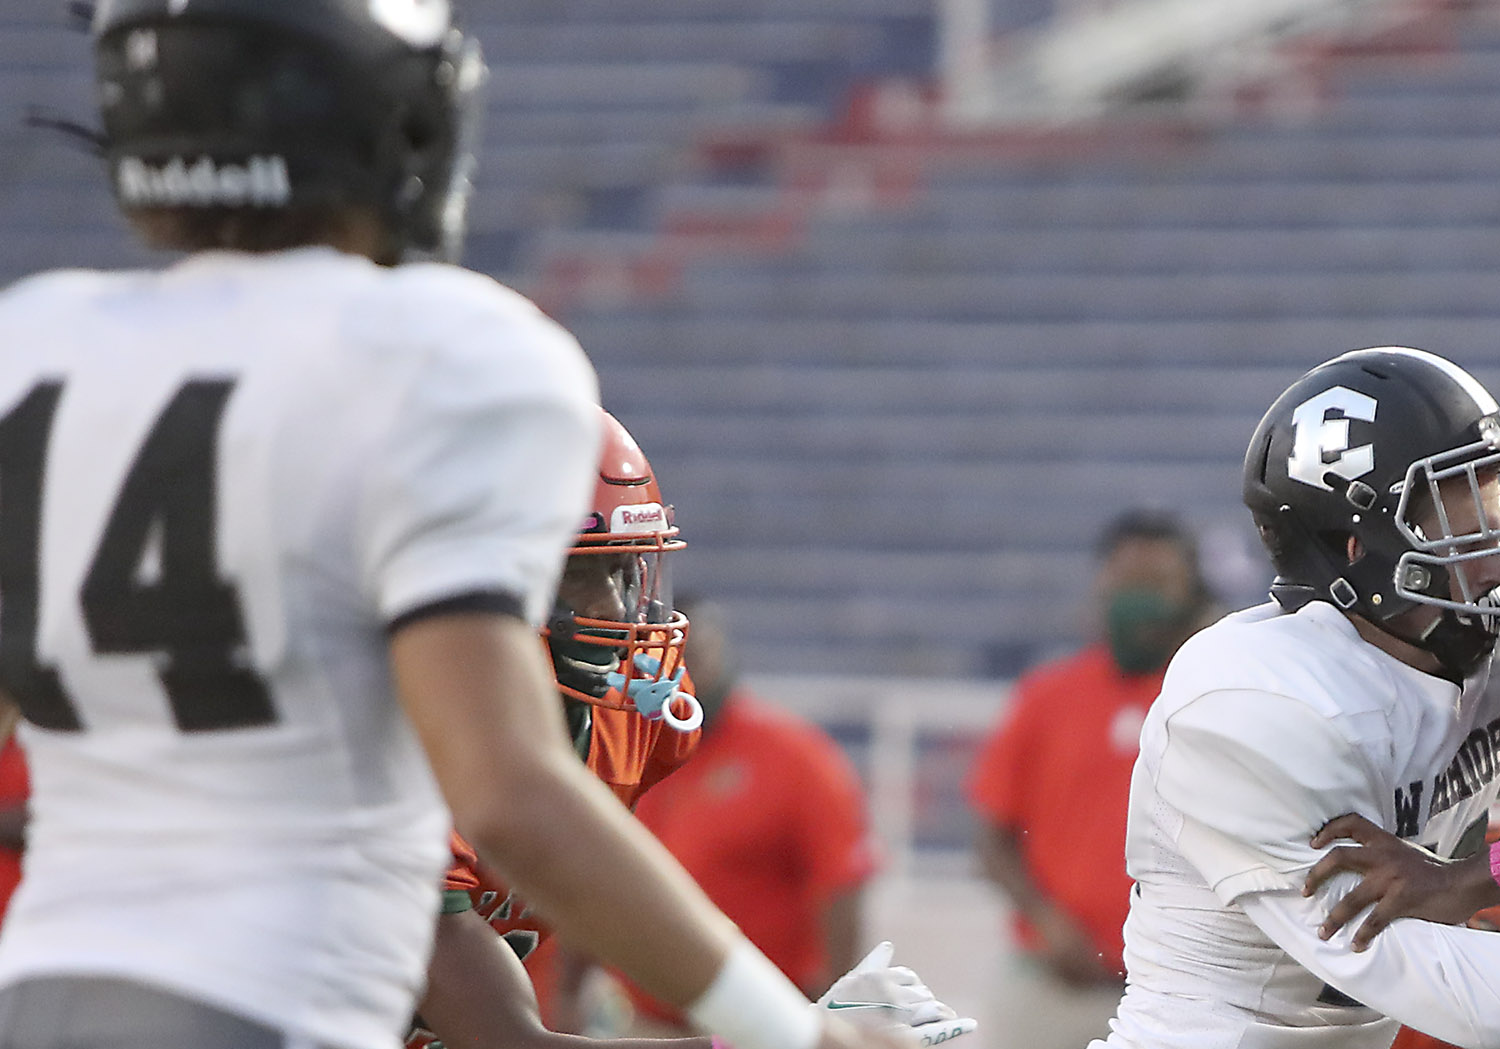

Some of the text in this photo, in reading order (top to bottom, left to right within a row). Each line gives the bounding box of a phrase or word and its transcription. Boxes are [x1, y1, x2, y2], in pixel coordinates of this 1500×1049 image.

[118, 152, 292, 206] Riddell
[1287, 384, 1378, 492] E
[0, 370, 283, 733] 14
